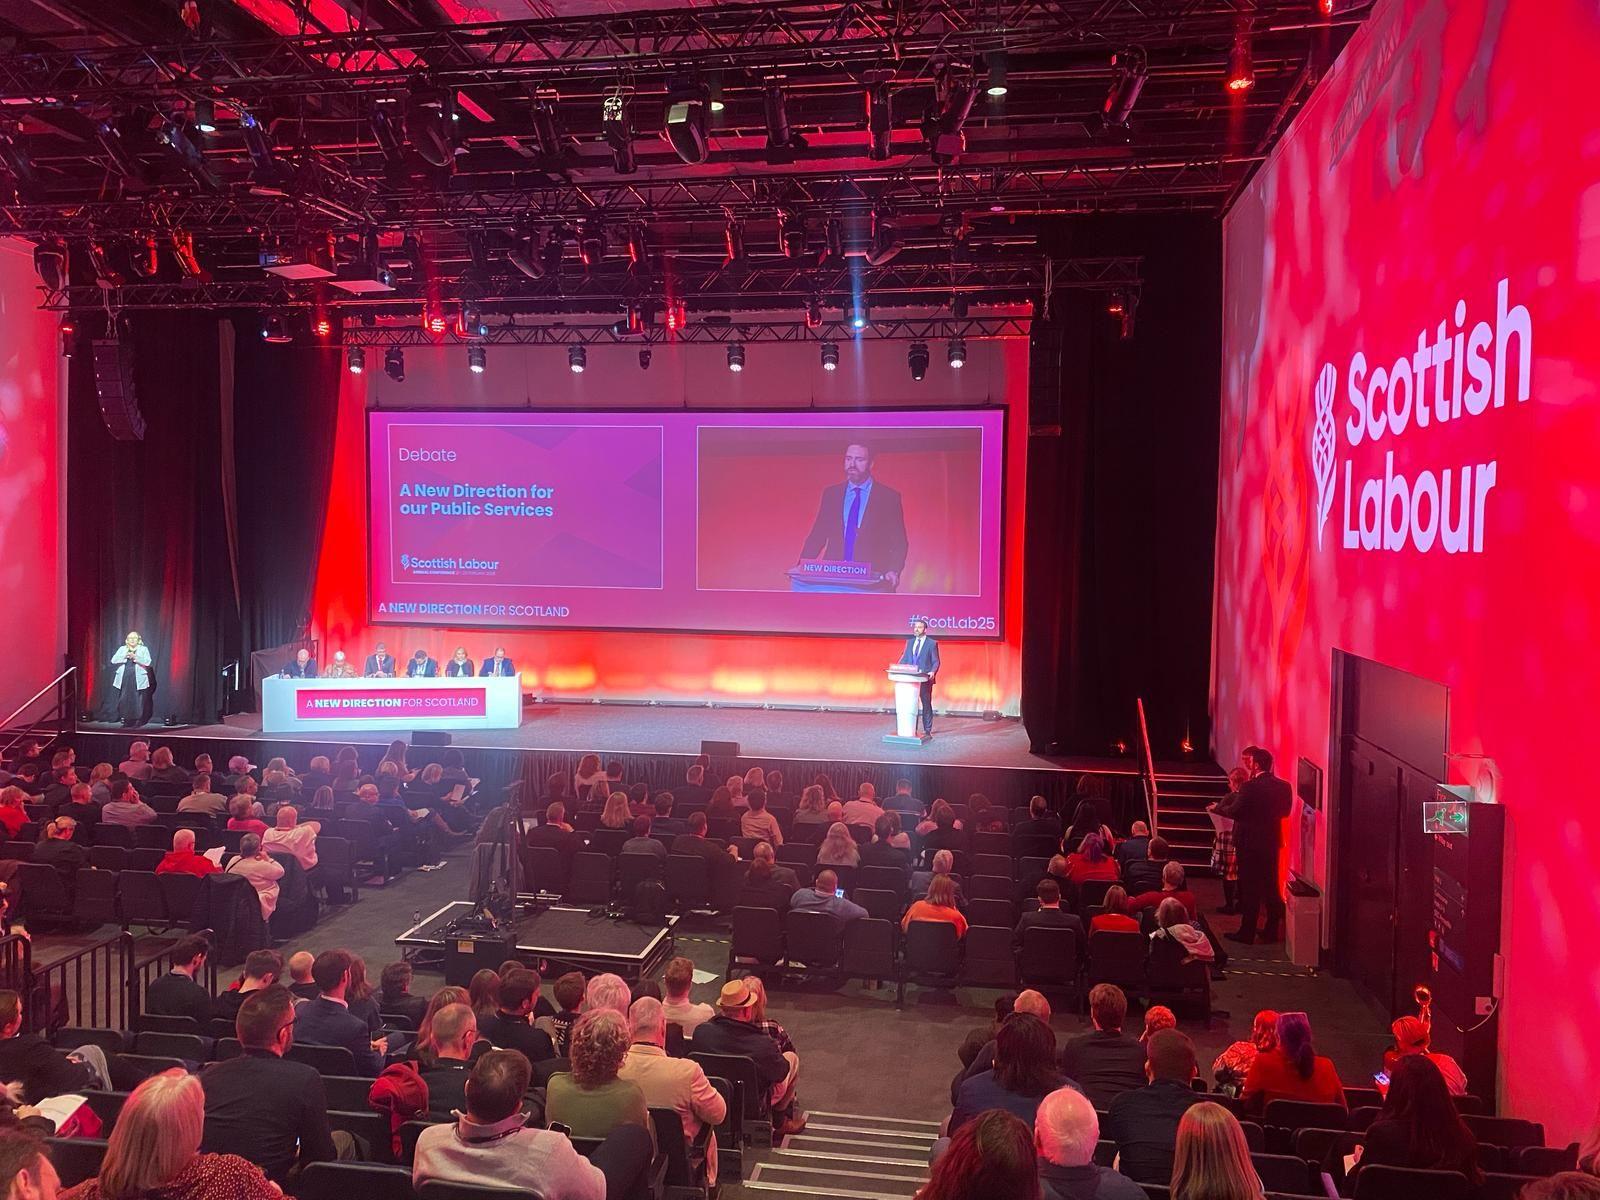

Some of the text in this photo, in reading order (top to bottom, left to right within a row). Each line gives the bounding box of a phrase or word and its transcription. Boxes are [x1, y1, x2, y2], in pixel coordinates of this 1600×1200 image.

[1346, 277, 1532, 446] Scottish
[399, 447, 456, 462] Debate
[400, 484, 554, 499] A New Direction for
[400, 502, 553, 517] our Public Services
[1343, 450, 1497, 554] Labour
[410, 557, 499, 569] Scottish Labour
[803, 564, 867, 574] NEW DIRECTION
[378, 602, 570, 617] A NEW DIRECTION FOR SCOTLAND
[306, 697, 479, 708] A NEW DIRECTION FOR SCOTLAND
